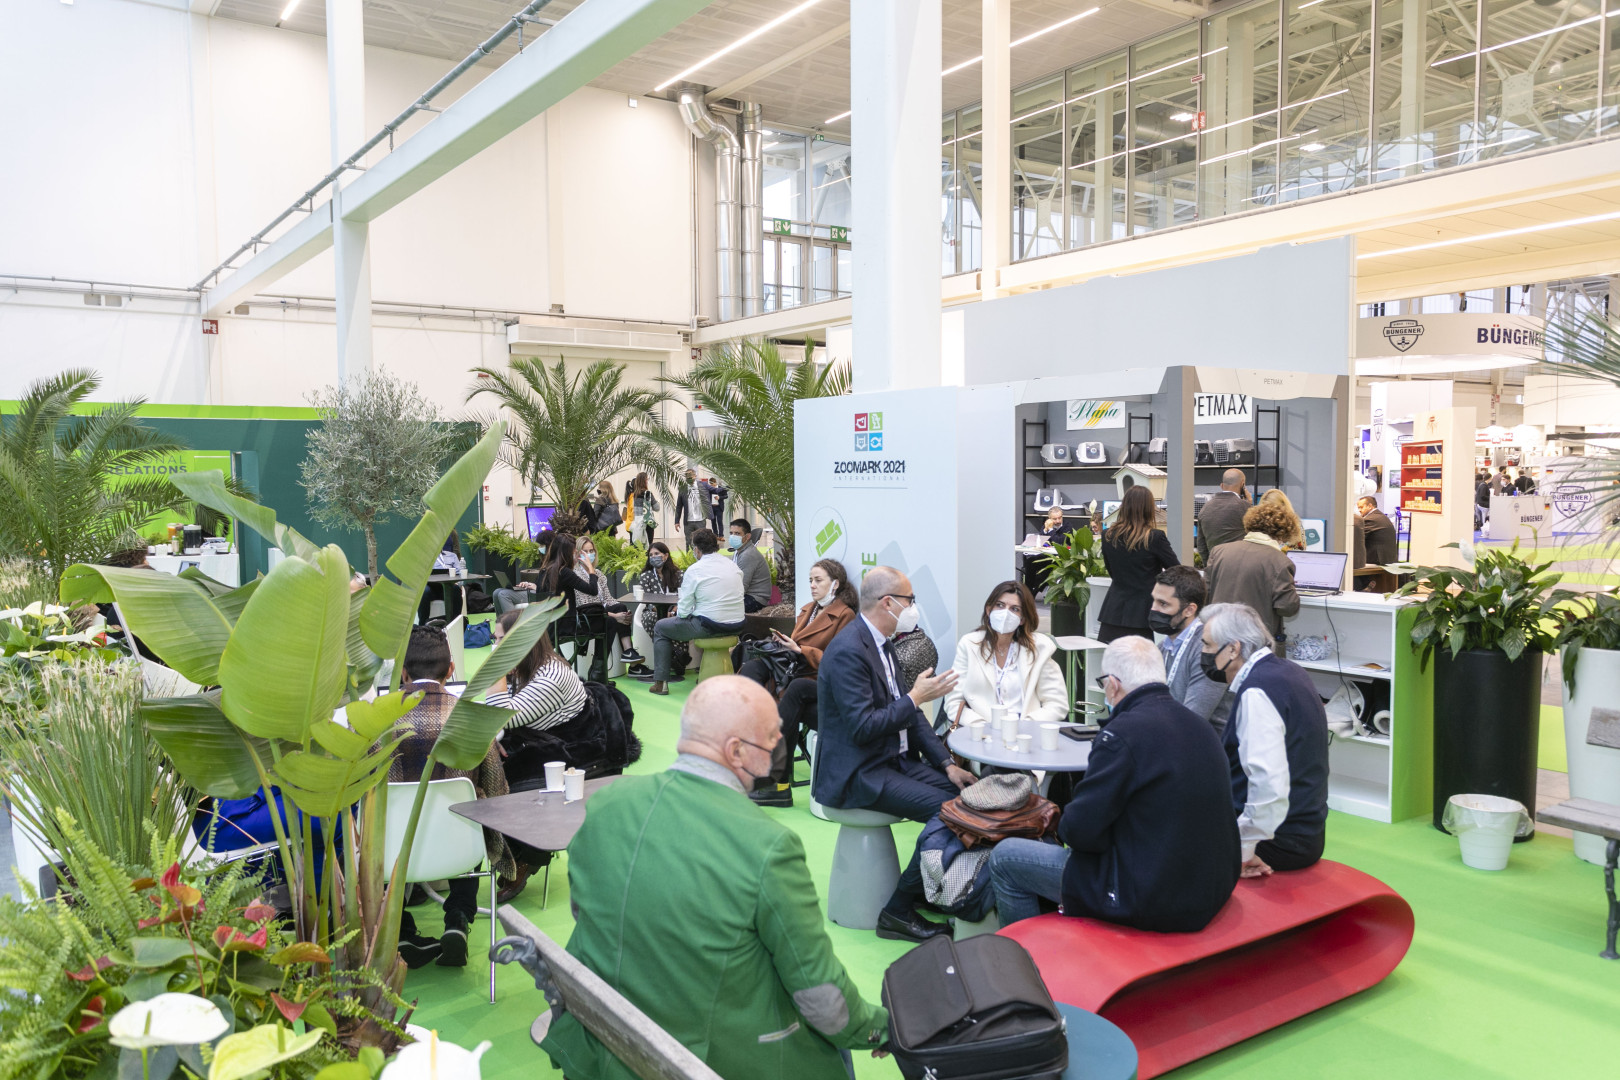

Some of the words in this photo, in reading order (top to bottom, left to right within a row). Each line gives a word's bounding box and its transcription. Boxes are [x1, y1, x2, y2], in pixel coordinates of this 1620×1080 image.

[1477, 323, 1542, 347] BÜNGENE
[1194, 394, 1248, 416] ETMAX
[834, 460, 882, 474] ZOOMARK
[883, 459, 906, 474] 2021
